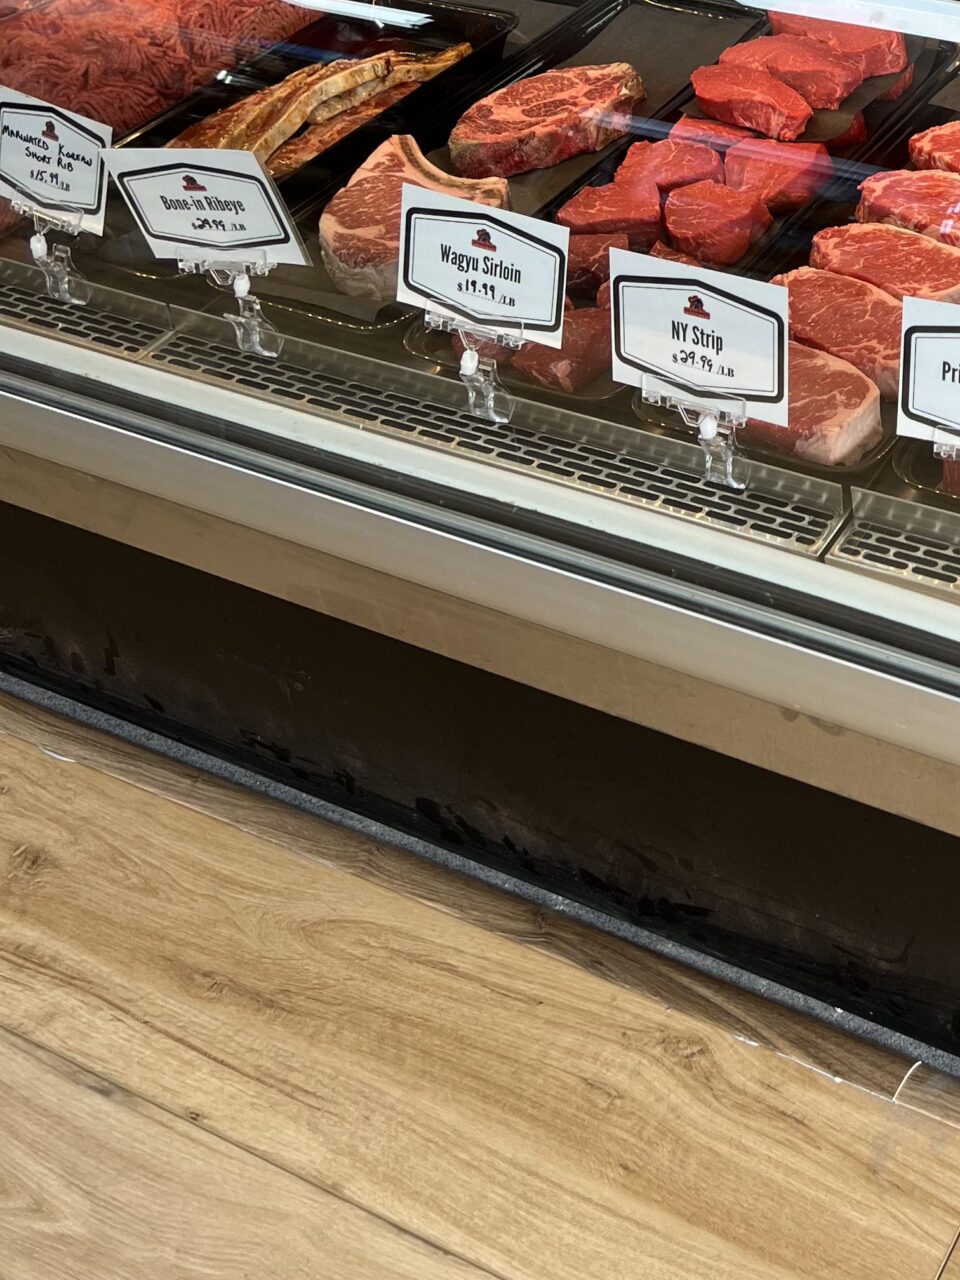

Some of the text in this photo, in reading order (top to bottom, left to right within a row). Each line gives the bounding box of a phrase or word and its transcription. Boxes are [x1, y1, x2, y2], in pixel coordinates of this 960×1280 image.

[160, 195, 246, 215] Bone-in Ribeye
[440, 243, 521, 284] Wagyu Sirloin
[671, 319, 723, 356] NY Strip
